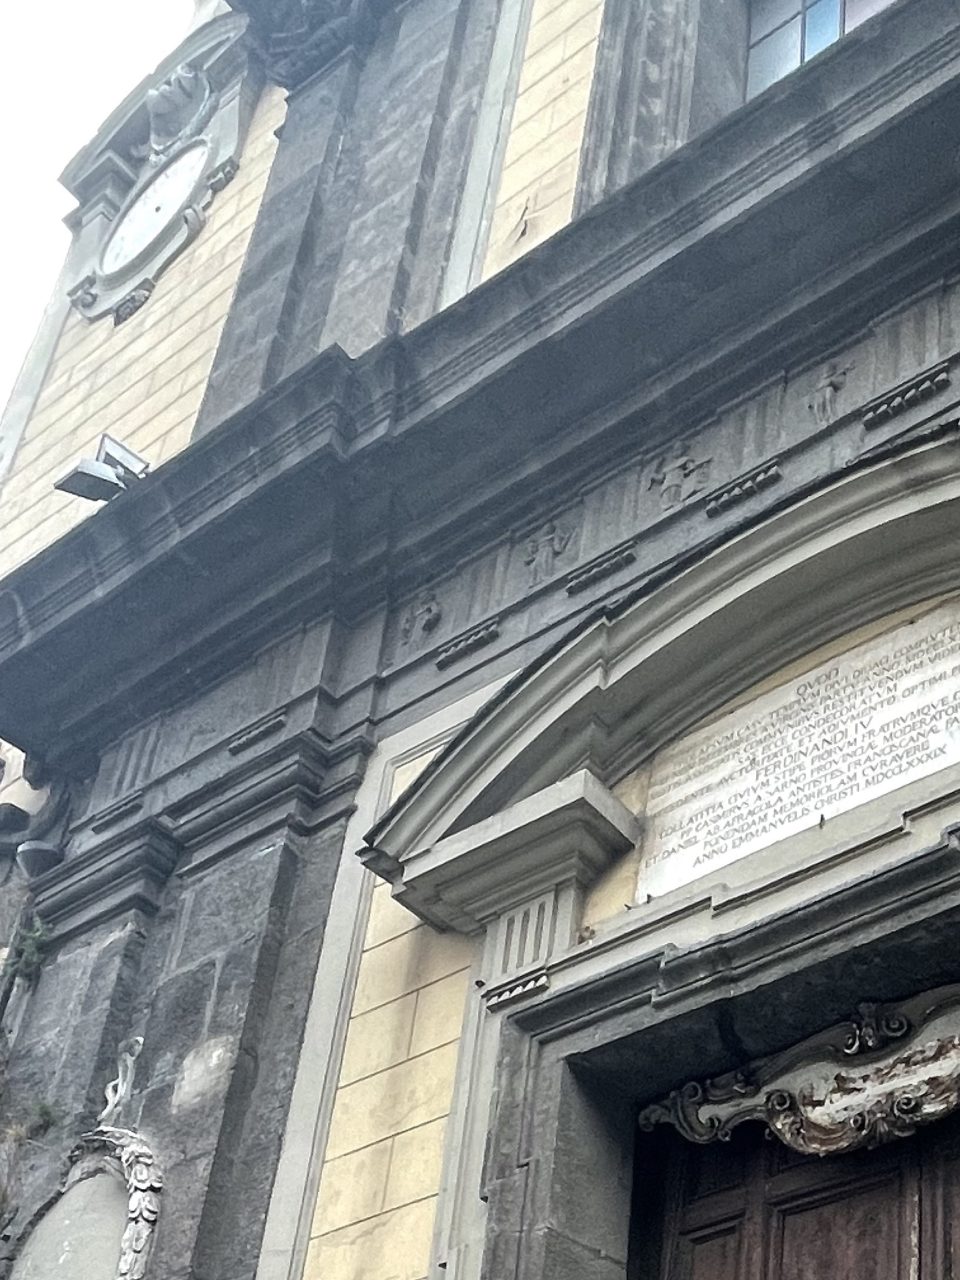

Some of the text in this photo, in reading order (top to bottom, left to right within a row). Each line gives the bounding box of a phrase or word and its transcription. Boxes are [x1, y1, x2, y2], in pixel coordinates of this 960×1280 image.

[768, 687, 820, 721] TEMPLVM
[796, 665, 839, 699] QVOD
[797, 732, 814, 748] ET
[901, 669, 947, 700] OPTIMI
[822, 658, 923, 715] RESTITVENDVM
[791, 681, 897, 741] CONDECORATVM
[861, 693, 949, 745] FRATRVMQVE
[755, 714, 873, 781] FERDINANDI IV
[692, 842, 728, 868] ANNO
[813, 781, 859, 812] CHRISTI
[644, 853, 658, 869] ET
